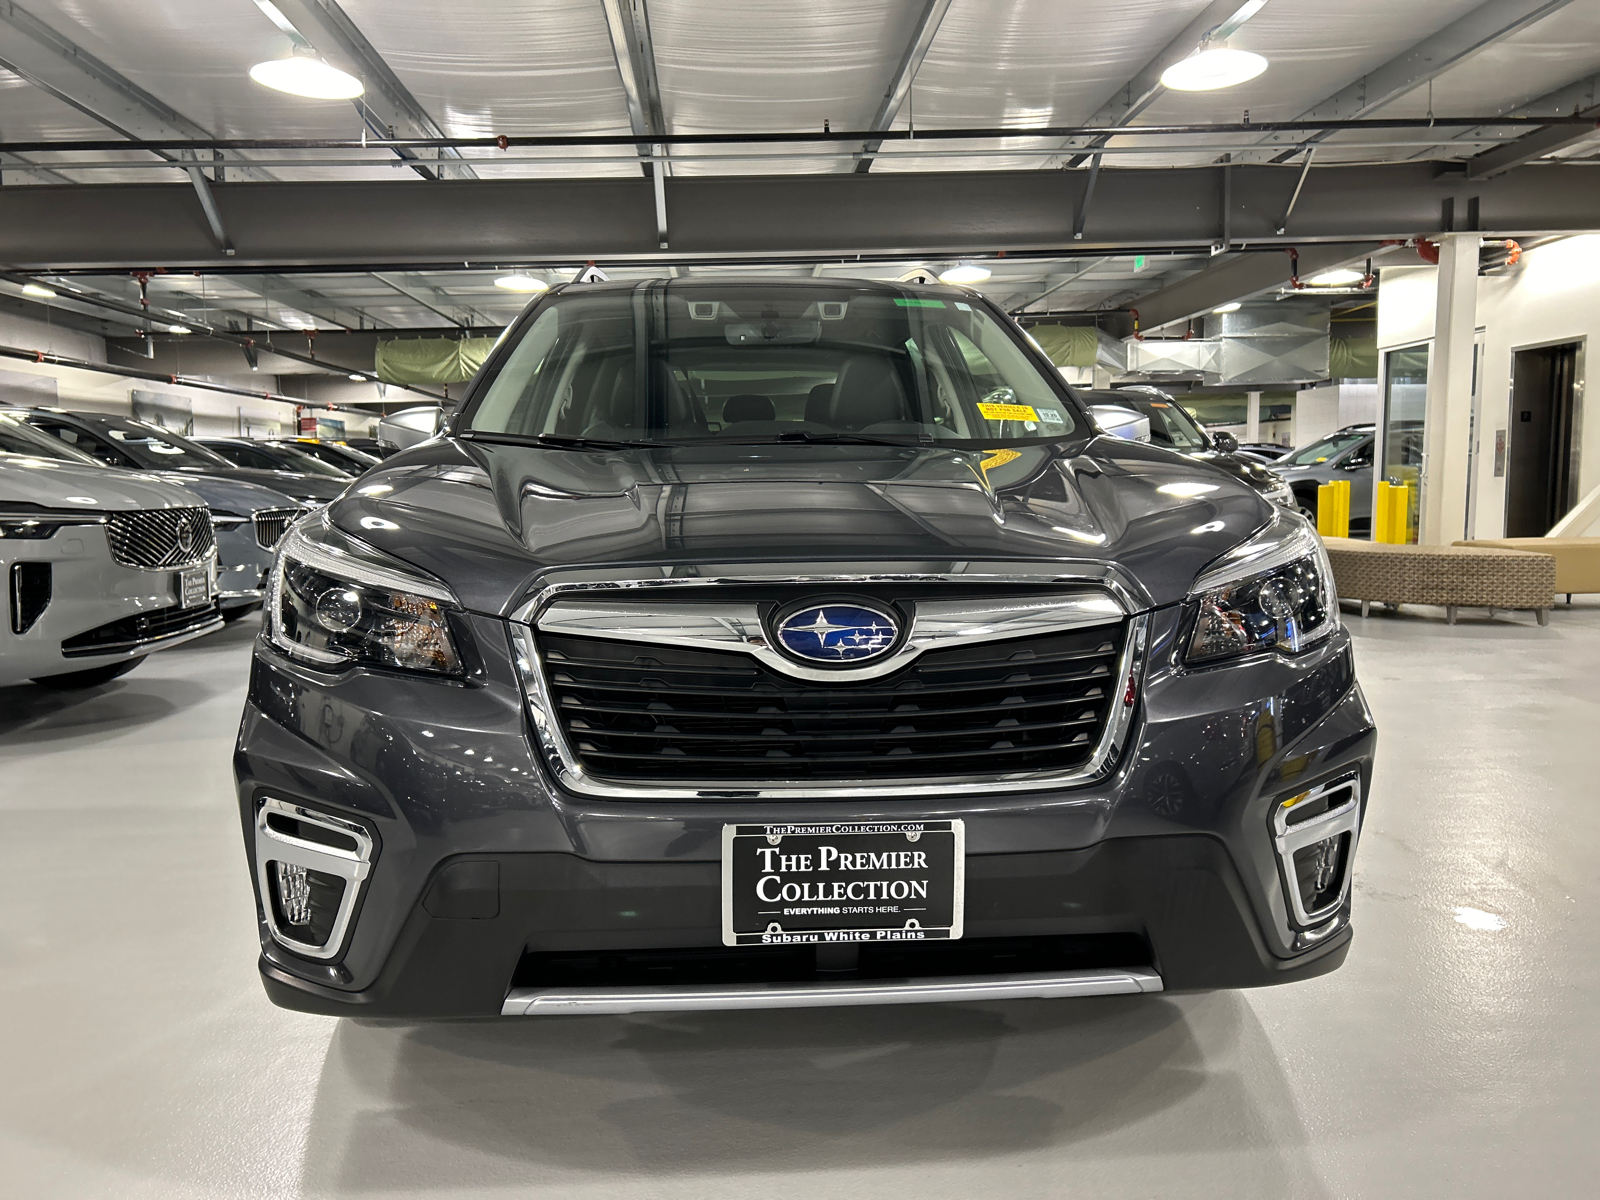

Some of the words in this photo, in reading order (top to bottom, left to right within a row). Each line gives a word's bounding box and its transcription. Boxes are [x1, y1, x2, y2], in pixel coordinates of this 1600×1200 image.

[756, 847, 813, 872] THE
[818, 846, 929, 871] PREMIER
[756, 875, 929, 902] COLLECTION
[783, 907, 840, 915] EVERYTHING
[842, 906, 874, 914] STARTS
[875, 905, 901, 913] HERE.
[762, 934, 818, 943] Subaru
[824, 931, 870, 941] White
[876, 930, 925, 940] Plains
